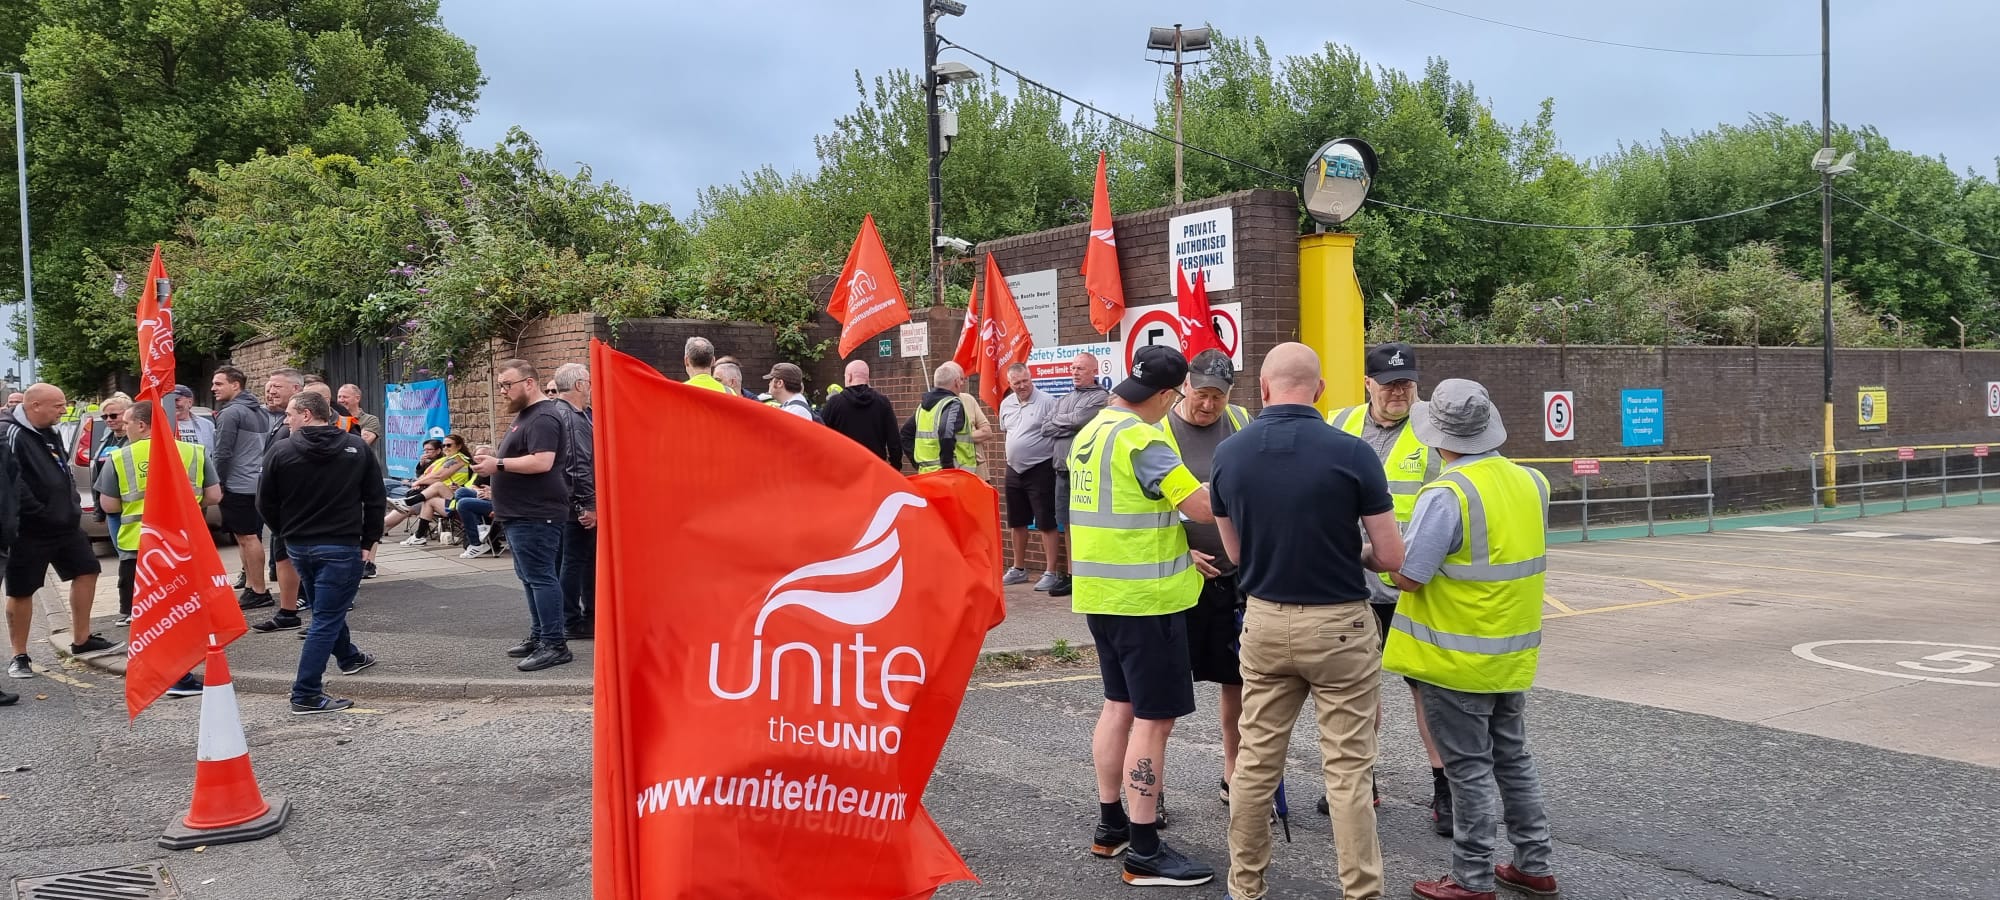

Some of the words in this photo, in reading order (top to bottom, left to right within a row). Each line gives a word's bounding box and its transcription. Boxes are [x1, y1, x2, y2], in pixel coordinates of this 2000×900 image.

[1183, 220, 1217, 238] PRIVATE
[1176, 235, 1226, 256] AUTHORISED
[1178, 251, 1225, 270] PERSONNEL
[1191, 269, 1212, 285] OLY
[1028, 348, 1054, 362] Safety
[1057, 346, 1085, 359] Starts
[1088, 343, 1111, 356] Here
[1036, 366, 1054, 376] Speed
[1055, 365, 1069, 374] limit
[1104, 362, 1109, 372] 5
[1555, 403, 1563, 423] 5
[1071, 467, 1092, 491] nite
[1895, 650, 2000, 673] 5
[708, 632, 926, 713] unite
[767, 716, 902, 755] theUNIO
